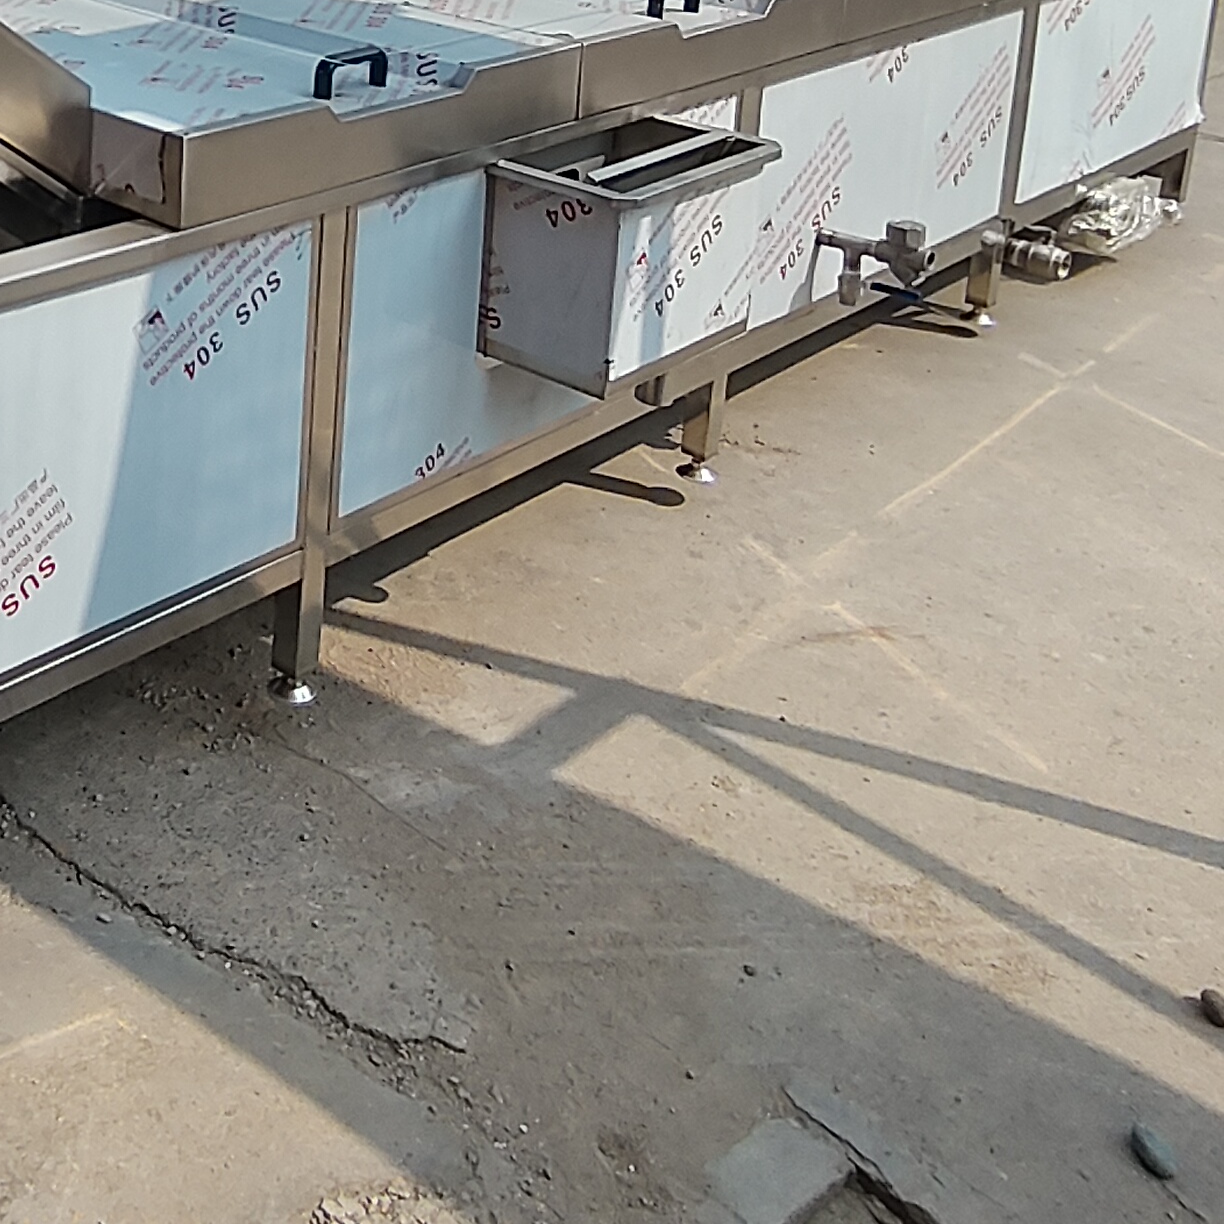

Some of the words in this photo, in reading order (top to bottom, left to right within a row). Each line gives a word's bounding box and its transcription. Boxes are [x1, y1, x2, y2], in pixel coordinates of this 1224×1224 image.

[545, 198, 593, 228] 304
[811, 186, 841, 233] SUS
[689, 214, 724, 268] SUS
[779, 238, 805, 280] 304
[235, 269, 282, 326] SUS
[654, 268, 686, 318] 304
[182, 331, 224, 381] 304
[26, 483, 59, 518] leave
[6, 516, 27, 539] the
[31, 520, 45, 536] in
[34, 511, 74, 555] Please
[0, 533, 32, 567] three
[9, 552, 35, 580] tear
[0, 554, 57, 618] SUS
